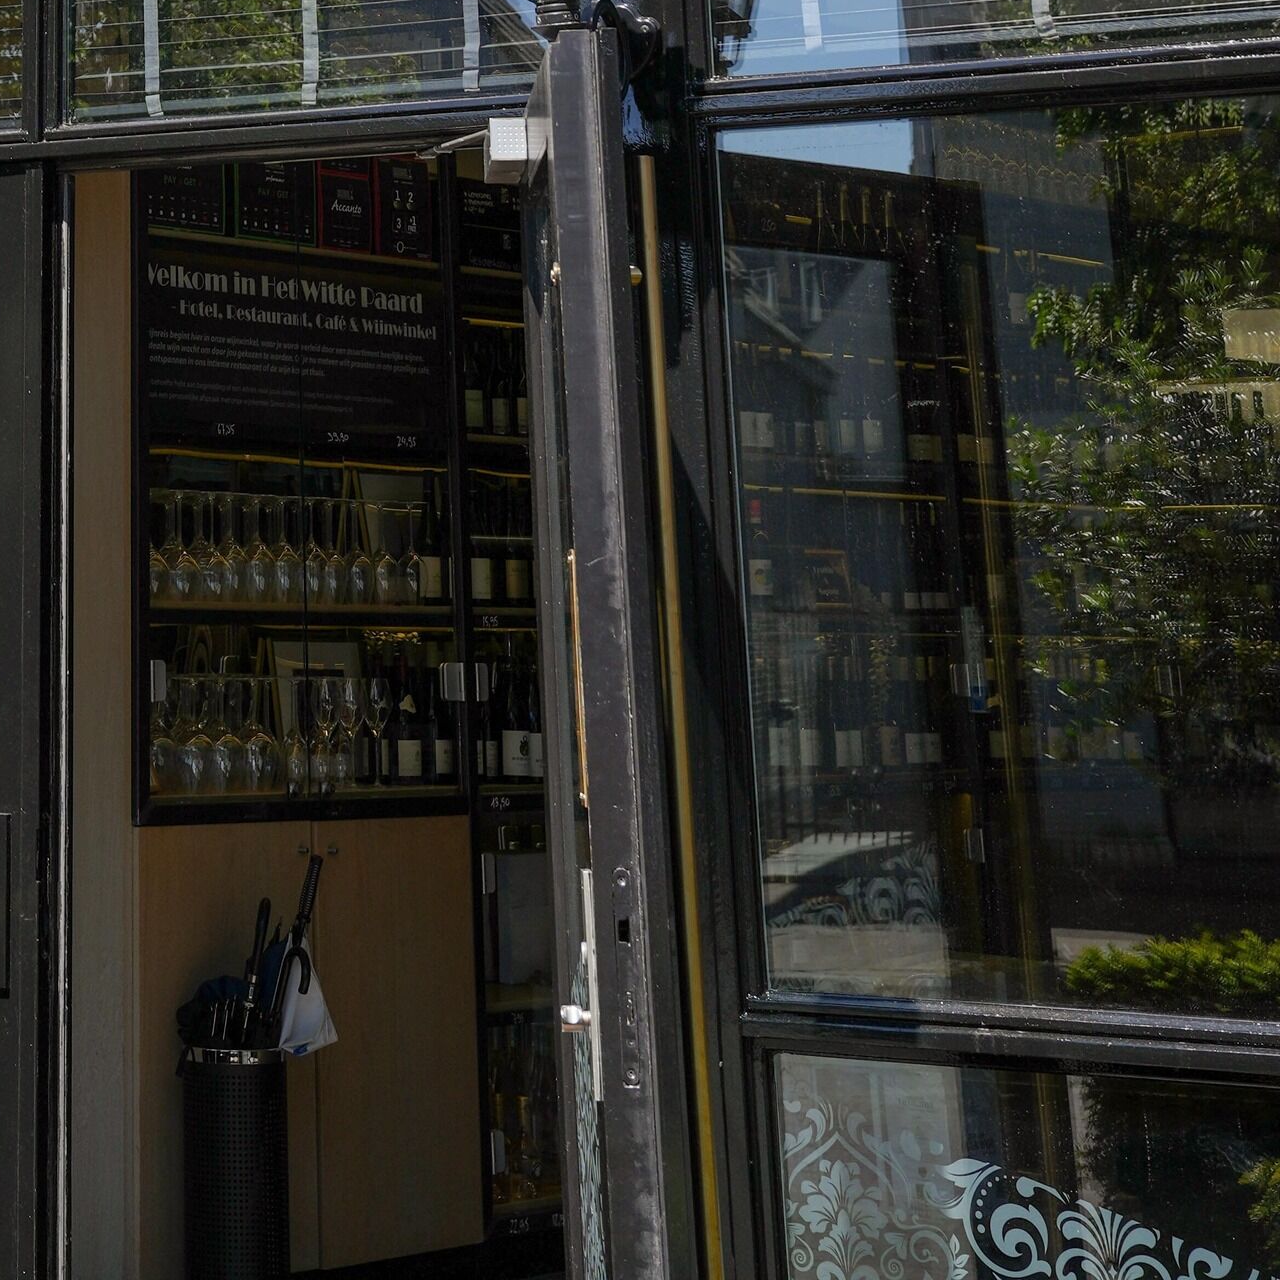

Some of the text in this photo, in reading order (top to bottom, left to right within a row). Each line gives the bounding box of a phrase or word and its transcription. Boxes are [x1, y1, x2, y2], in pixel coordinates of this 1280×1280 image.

[233, 270, 256, 296] in
[261, 274, 299, 301] Het
[300, 278, 357, 307] Witte
[360, 285, 423, 314] Paard
[315, 312, 346, 331] Café
[349, 316, 360, 333] &
[361, 317, 437, 340] Wijnwinkel
